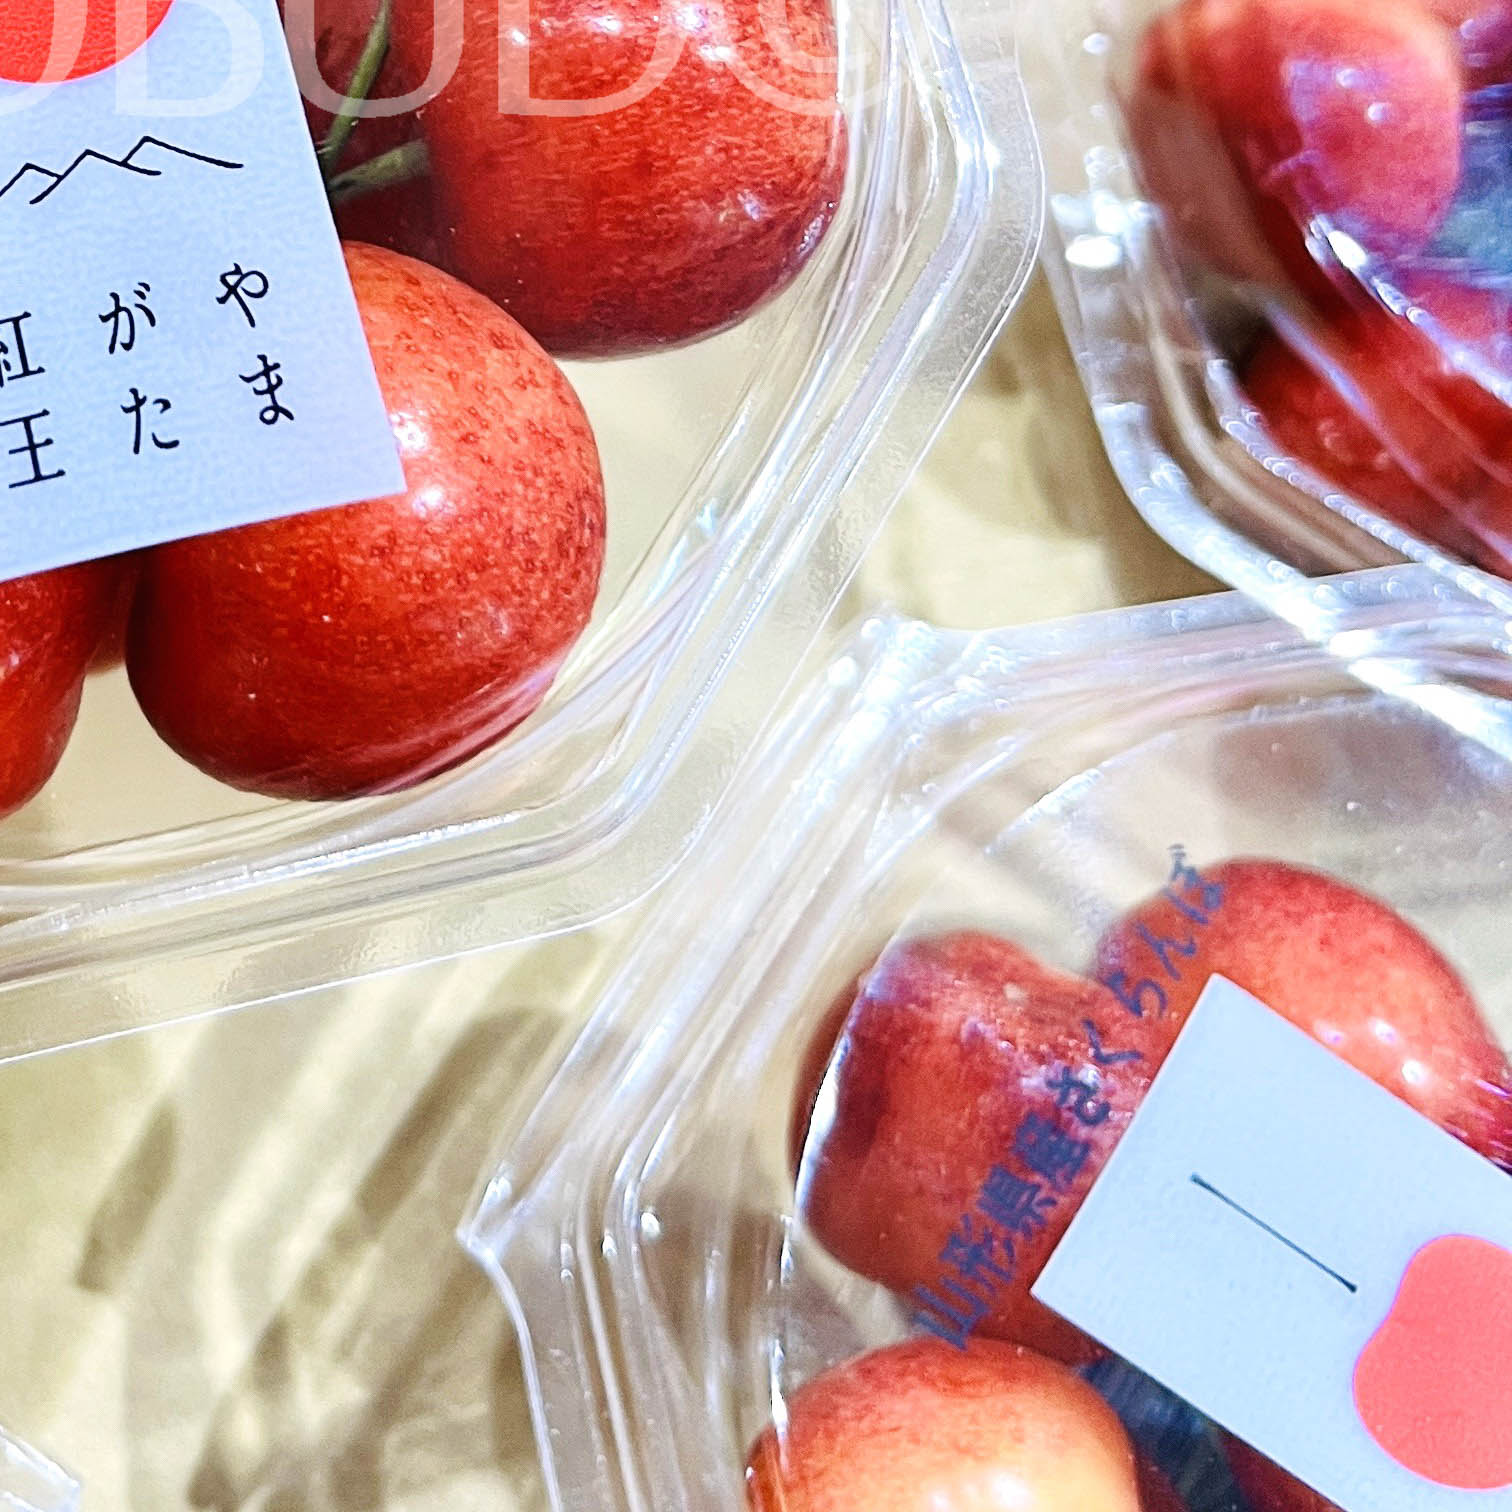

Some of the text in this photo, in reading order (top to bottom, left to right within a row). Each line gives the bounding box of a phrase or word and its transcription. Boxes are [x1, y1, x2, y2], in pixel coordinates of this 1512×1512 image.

[913, 844, 1225, 1351] 山形県産さくらんぼ
